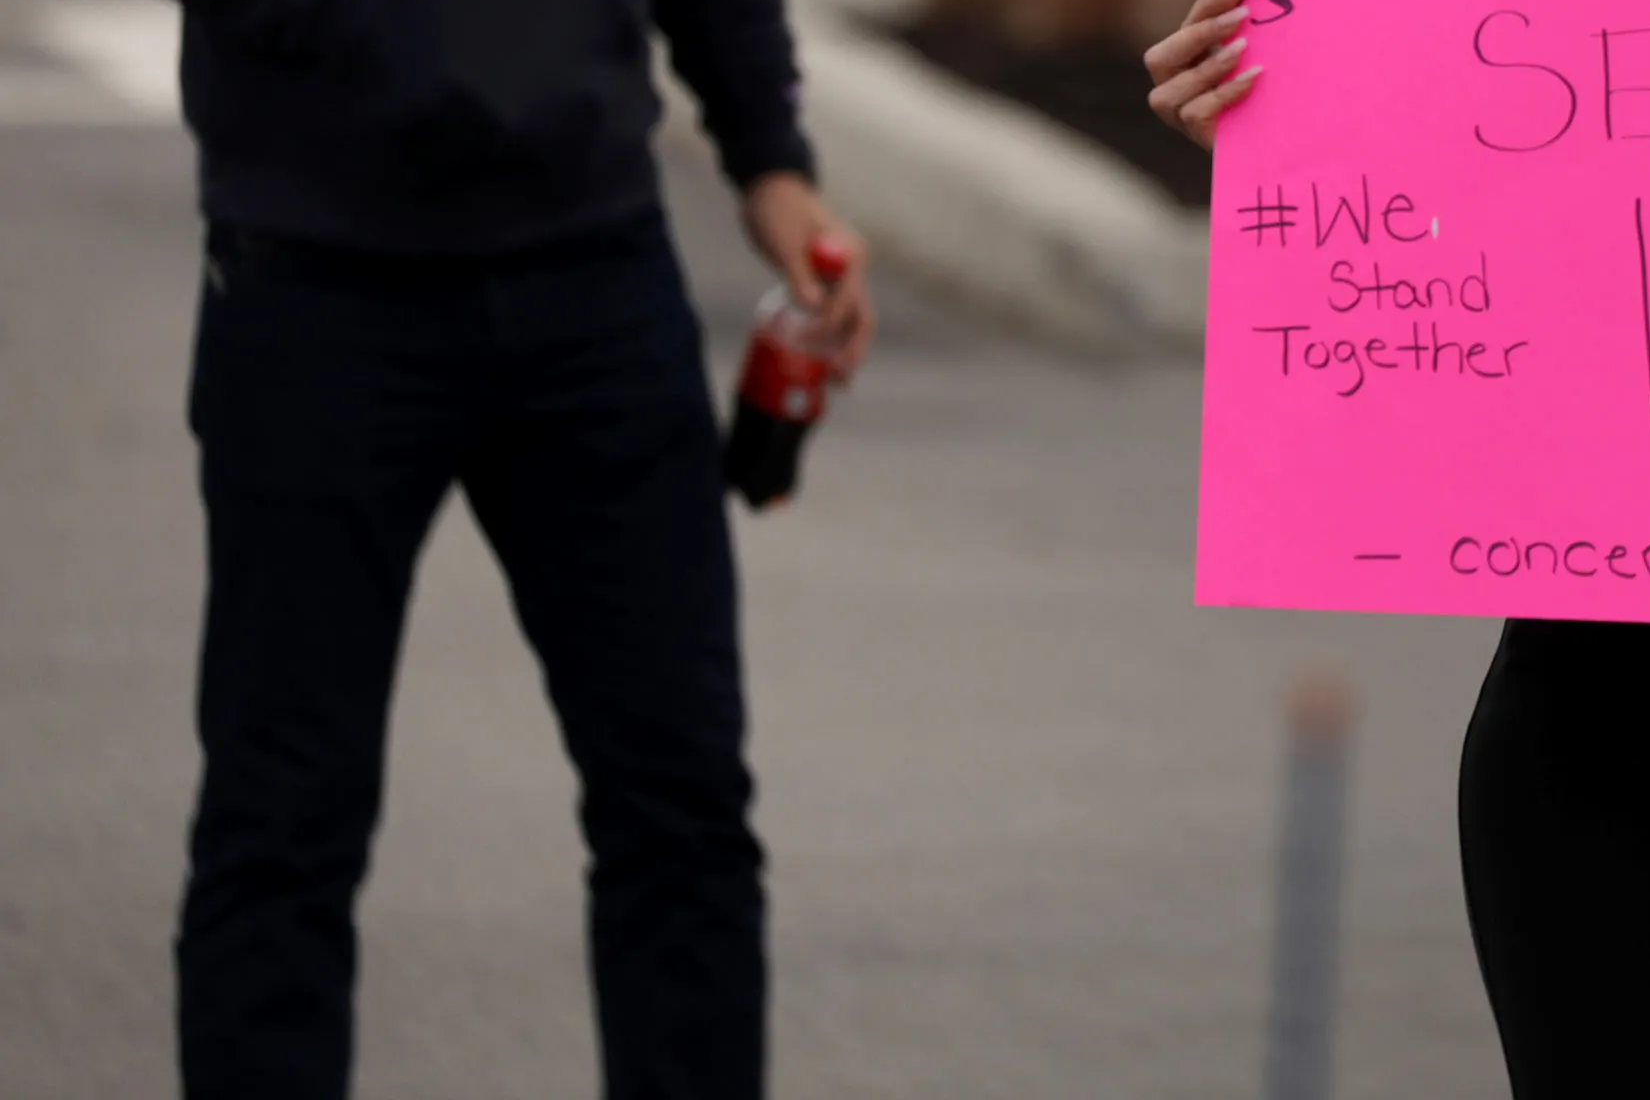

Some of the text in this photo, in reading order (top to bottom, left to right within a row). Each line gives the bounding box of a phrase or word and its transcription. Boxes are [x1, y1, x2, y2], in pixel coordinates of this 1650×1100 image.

[1237, 175, 1430, 249] #We
[1328, 252, 1491, 314] Stand
[1252, 321, 1529, 398] Together
